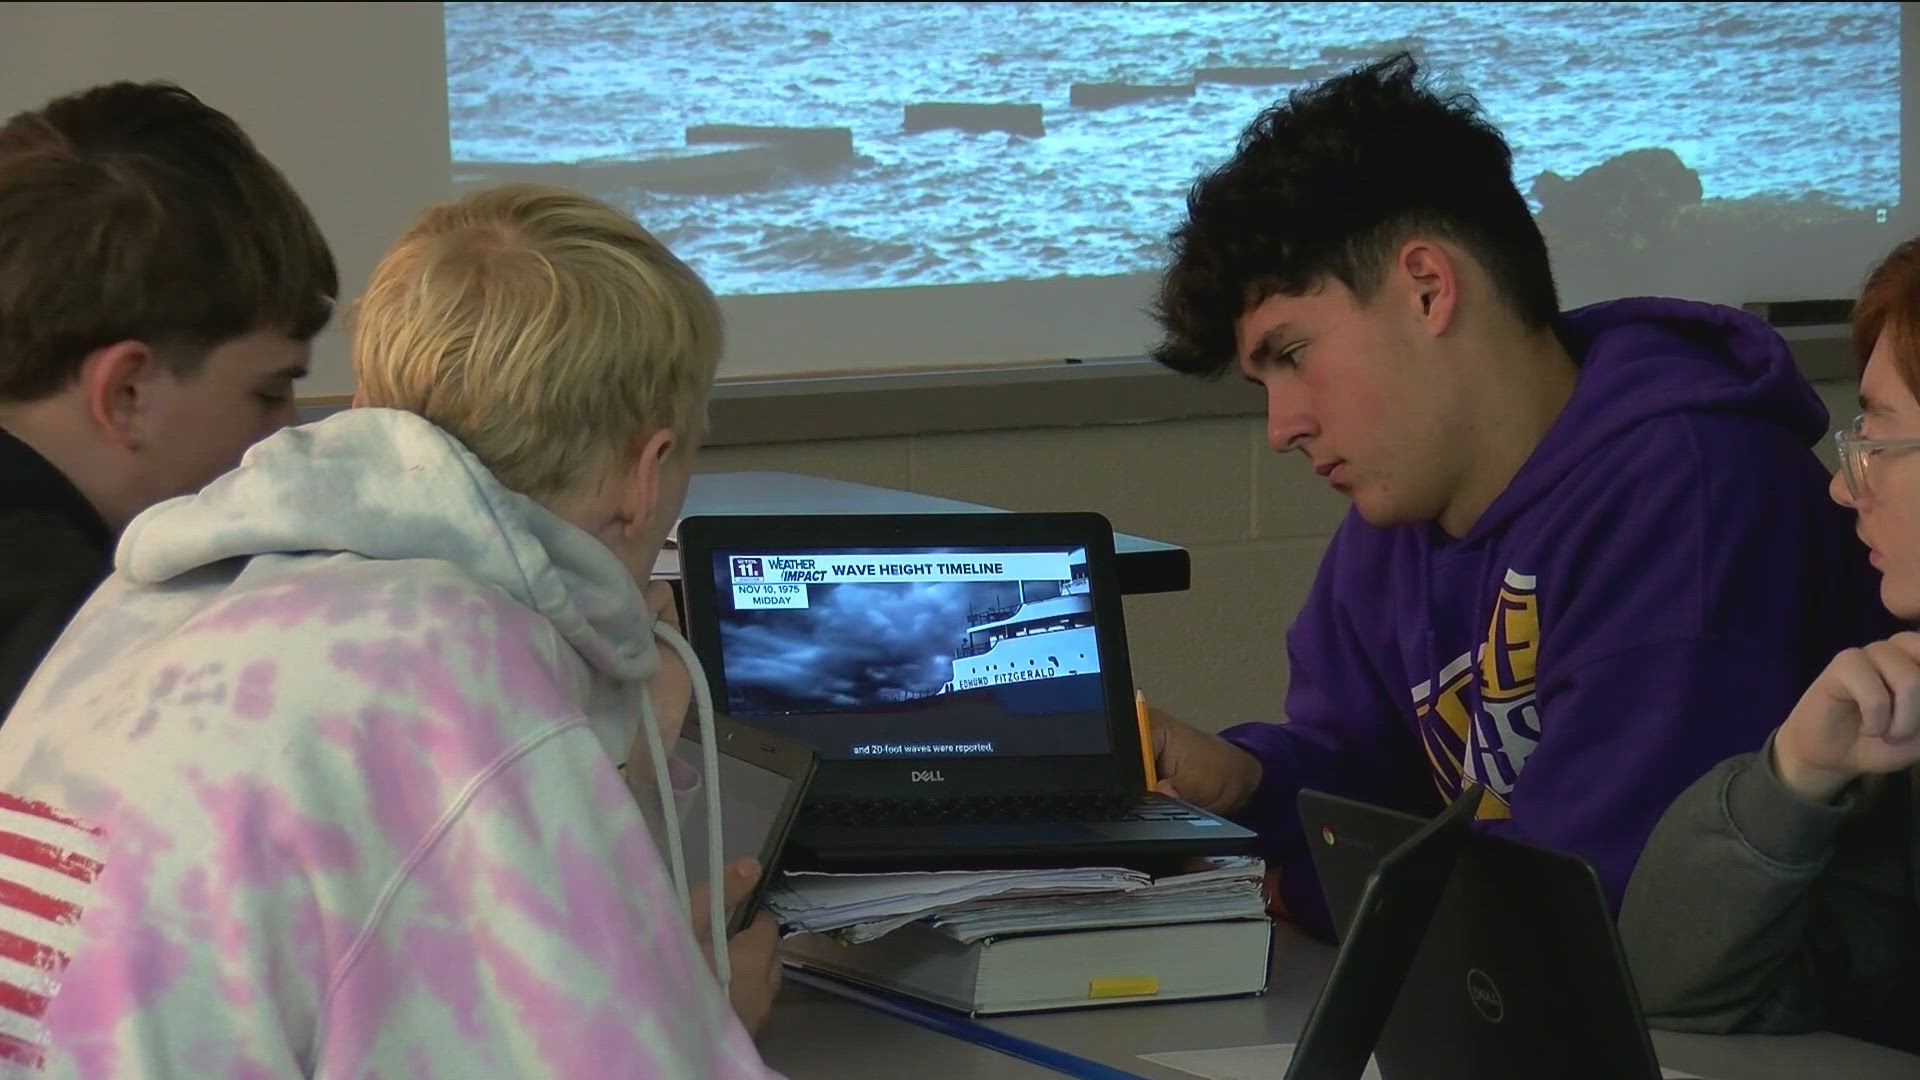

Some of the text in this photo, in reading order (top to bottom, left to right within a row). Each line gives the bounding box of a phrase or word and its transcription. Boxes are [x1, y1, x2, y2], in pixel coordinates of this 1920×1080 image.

[768, 557, 816, 570] WEATHER
[832, 563, 1003, 576] WAVE HEIGHT TIMELINE
[783, 570, 827, 582] IMPACT
[739, 585, 761, 594] NOV
[779, 585, 800, 594] 1975
[752, 596, 792, 605] MIDDAY
[959, 667, 1055, 690] EDMUND FITZGERALD
[853, 744, 870, 754] and
[904, 745, 932, 753] waves
[933, 744, 954, 752] were
[911, 770, 945, 782] DELL
